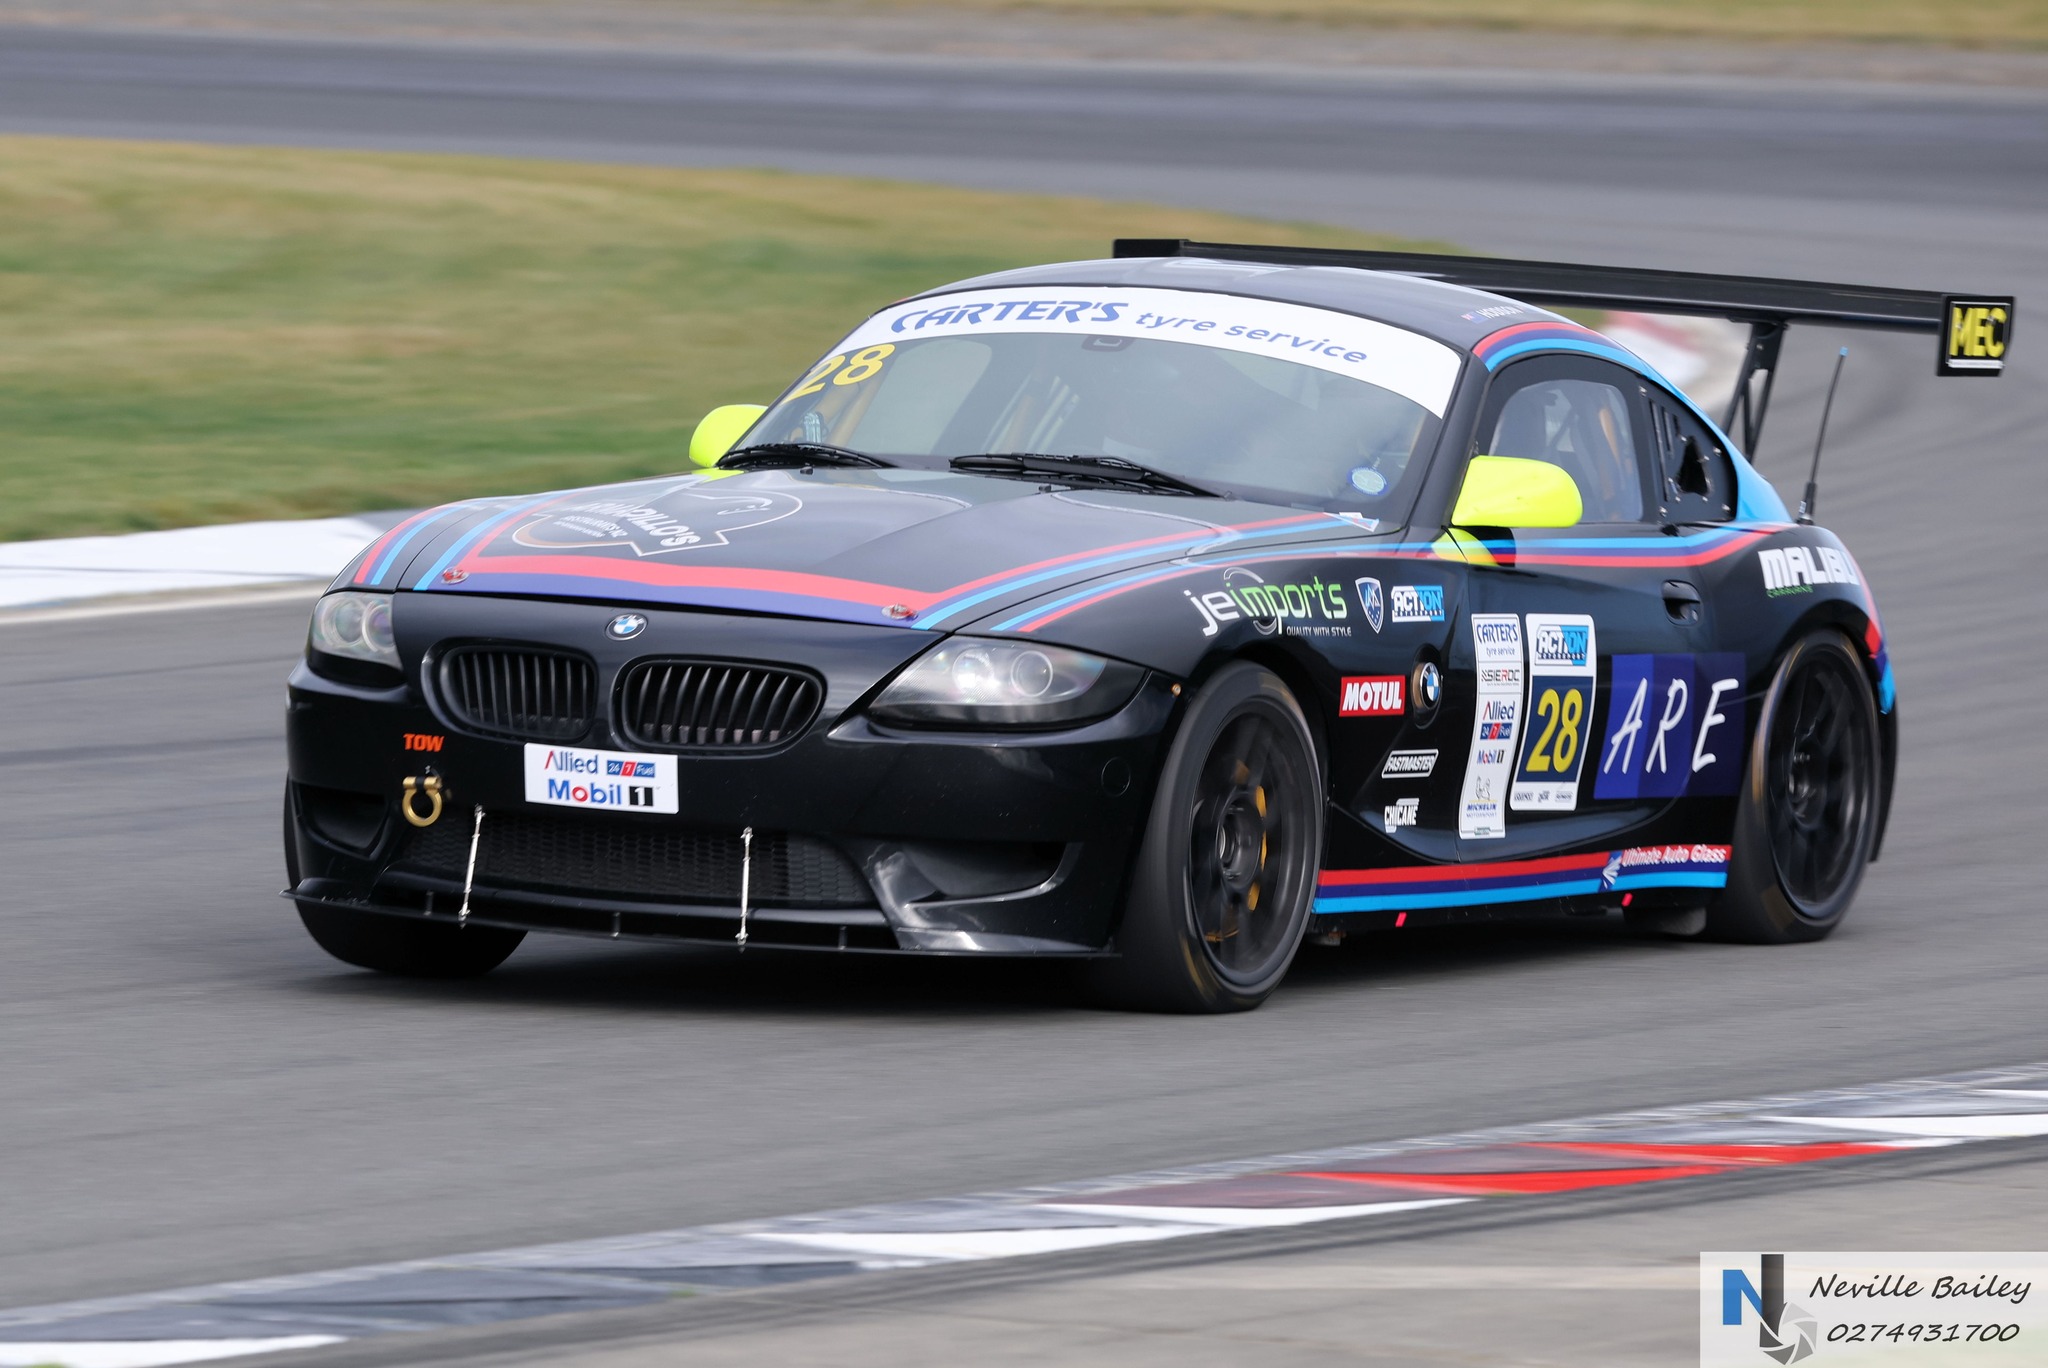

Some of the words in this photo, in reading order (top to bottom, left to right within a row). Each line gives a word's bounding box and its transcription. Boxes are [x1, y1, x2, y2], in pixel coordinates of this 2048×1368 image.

[890, 300, 1129, 333] CARTER'S
[1135, 312, 1217, 332] tyre
[1223, 324, 1368, 363] service
[1948, 306, 2008, 358] MEC
[780, 343, 896, 406] 28
[1393, 591, 1443, 612] ACTION
[1286, 625, 1312, 637] QUALITY
[1312, 626, 1331, 637] WITH
[1331, 626, 1352, 637] STYLE
[1476, 624, 1519, 643] CARTER'S
[1538, 630, 1587, 654] ACTION
[1486, 646, 1497, 657] tyre
[1498, 646, 1516, 655] service
[1342, 681, 1402, 711] MOTUL
[1483, 700, 1515, 720] Allied
[1525, 688, 1583, 773] 28
[1603, 677, 1739, 775] ARE
[403, 733, 445, 752] TOW
[544, 750, 598, 774] Allied
[1385, 755, 1435, 772] FASTMASTER
[1477, 749, 1496, 764] Mobil
[549, 778, 622, 806] Mobil
[1384, 804, 1418, 827] CHICANE
[1661, 846, 1689, 864] Auto
[1690, 844, 1727, 863] Glass
